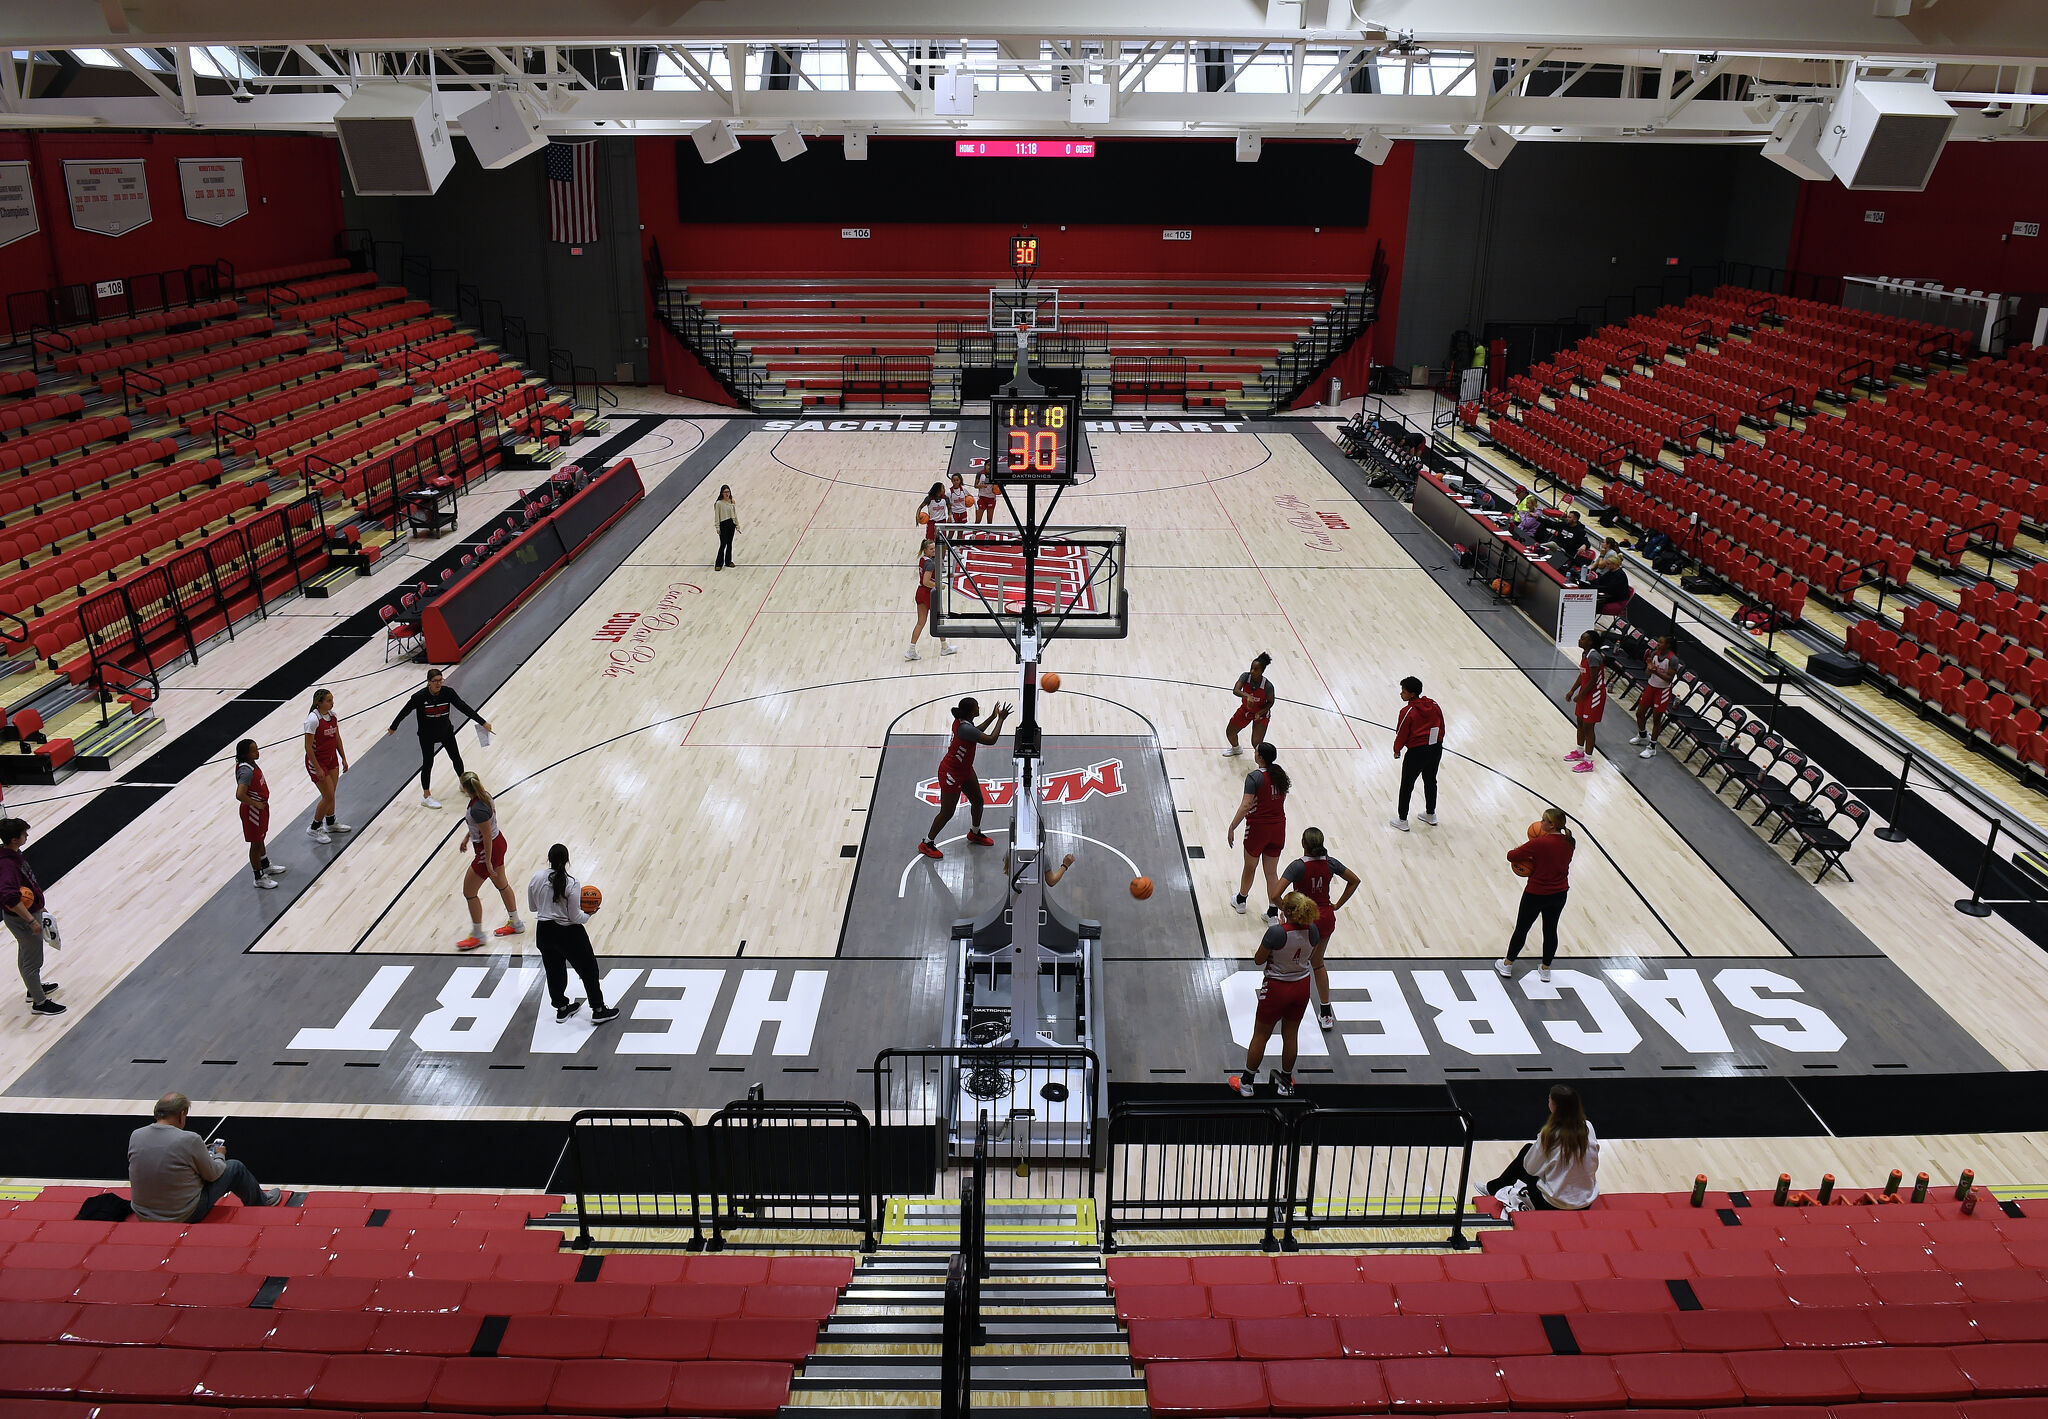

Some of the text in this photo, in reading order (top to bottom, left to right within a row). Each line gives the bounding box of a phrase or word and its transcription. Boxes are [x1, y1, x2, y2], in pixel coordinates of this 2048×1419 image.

[960, 143, 1092, 155] HOME 0 11:18 0 GUEST
[1873, 212, 1883, 221] 104
[854, 229, 869, 237] 106
[1175, 231, 1190, 239] 105
[2024, 223, 2038, 235] 103
[1016, 239, 1036, 249] 11:18
[1016, 248, 1034, 264] 30
[108, 281, 122, 294] 108
[1009, 406, 1064, 428] 11:18
[762, 421, 1244, 432] SACRED HEART
[1008, 431, 1057, 470] 30
[591, 612, 641, 643] COURT
[1784, 751, 1804, 765] SHU
[1803, 768, 1819, 782] SHU
[1825, 785, 1843, 799] SHU
[1844, 803, 1865, 818] SHU
[1311, 876, 1323, 889] 14
[286, 965, 1848, 1056] HEART SACRED
